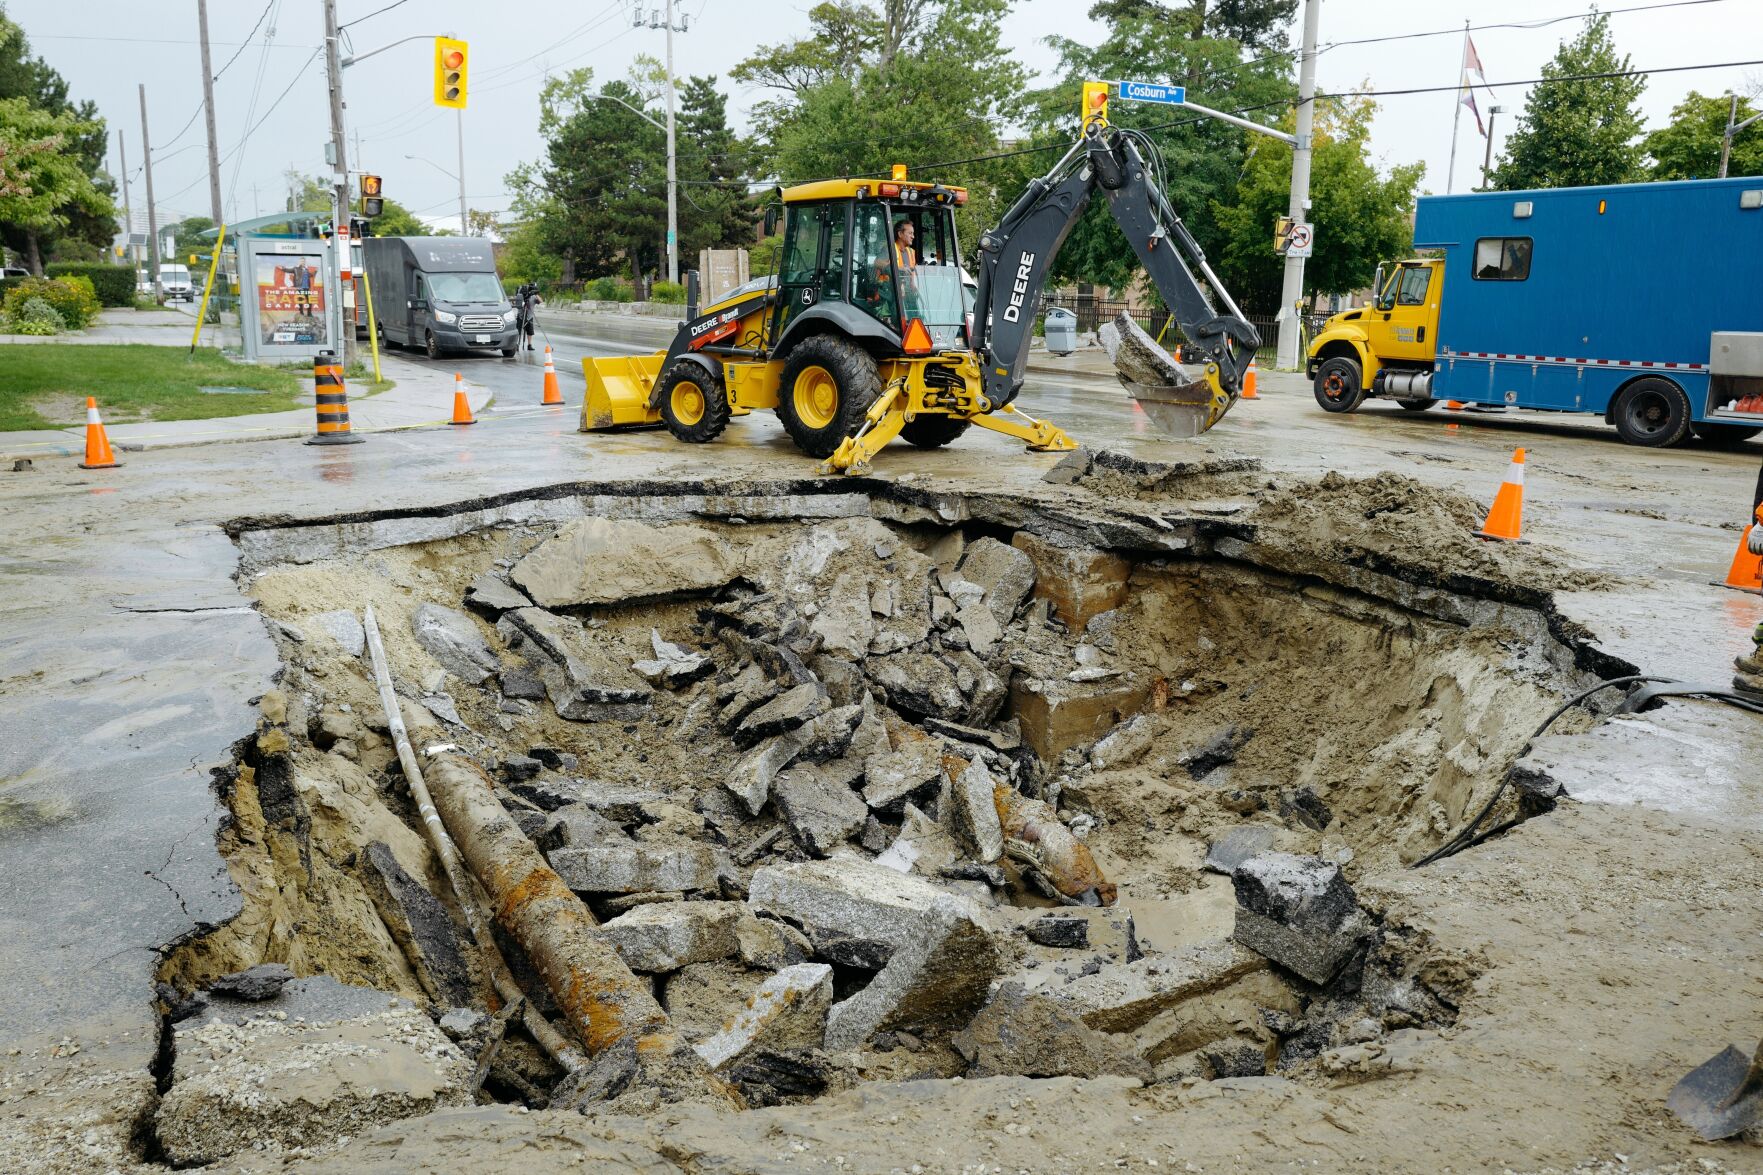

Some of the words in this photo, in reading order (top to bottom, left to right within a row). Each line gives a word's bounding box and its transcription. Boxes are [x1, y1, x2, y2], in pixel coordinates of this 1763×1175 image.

[1127, 84, 1166, 99] Cosburn
[1003, 251, 1035, 323] DEERE
[265, 295, 319, 304] RACE
[691, 317, 718, 336] DEERE
[731, 390, 736, 403] 3
